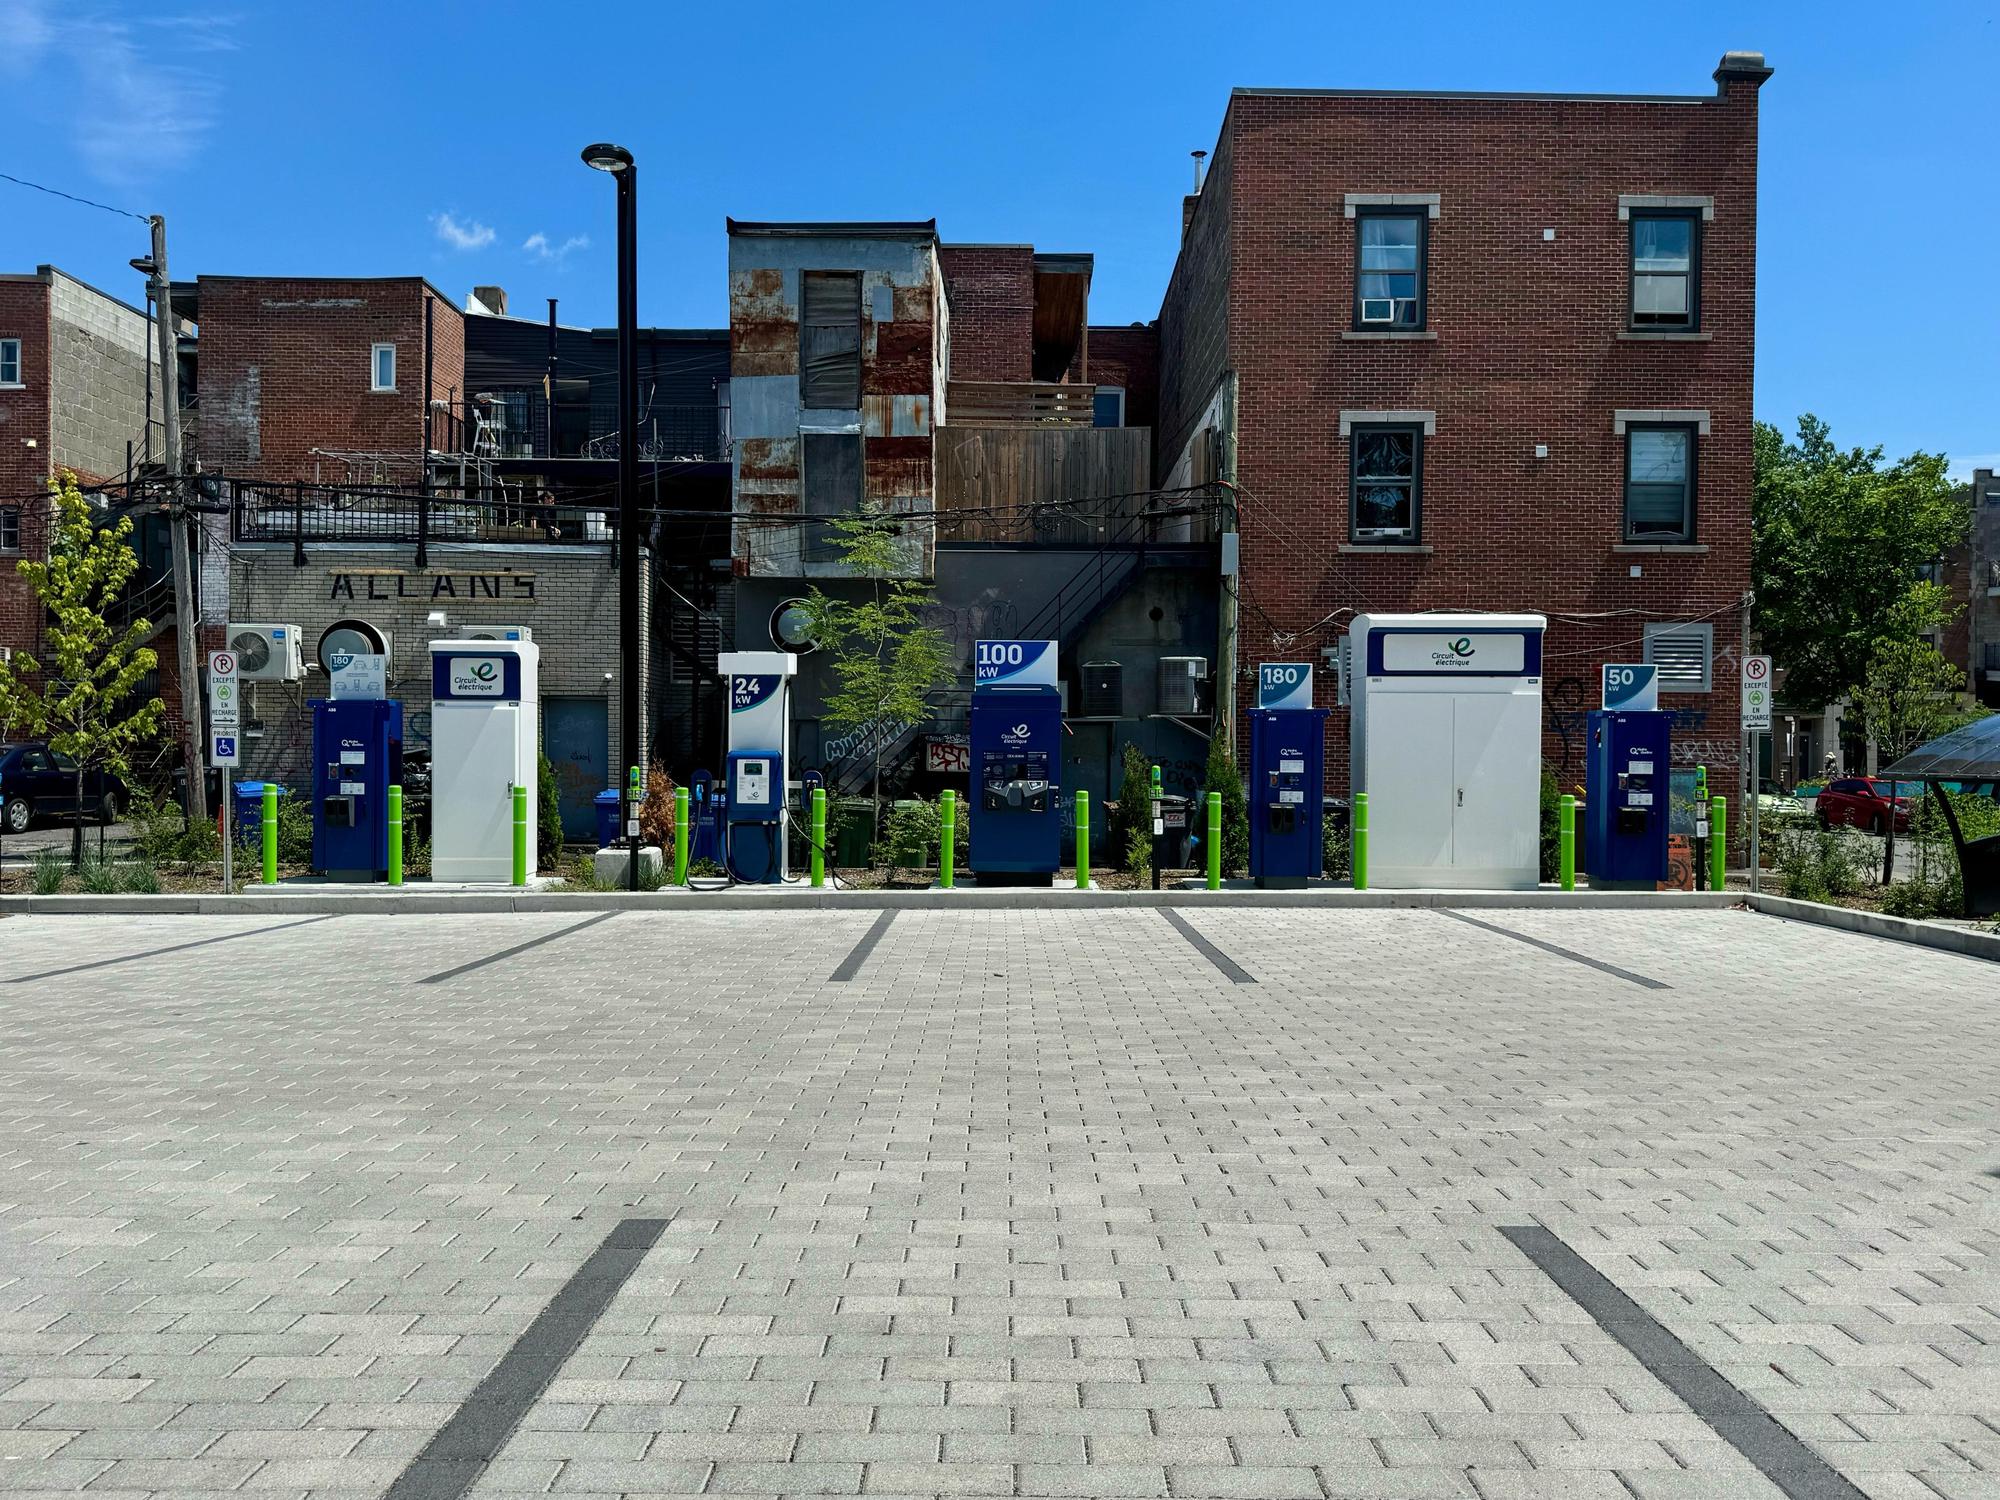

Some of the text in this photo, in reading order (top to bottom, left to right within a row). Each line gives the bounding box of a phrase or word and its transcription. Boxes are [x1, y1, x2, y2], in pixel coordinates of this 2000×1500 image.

[979, 644, 1022, 665] 100
[333, 656, 349, 664] 180
[1435, 658, 1470, 667] électrique
[979, 667, 998, 678] kW
[1264, 668, 1297, 684] 180
[1608, 669, 1634, 685] 50
[454, 676, 477, 684] Circuit
[458, 683, 493, 691] électrique
[735, 678, 760, 694] 24
[1744, 681, 1768, 689] EXCEPTÉ
[735, 695, 751, 704] kW
